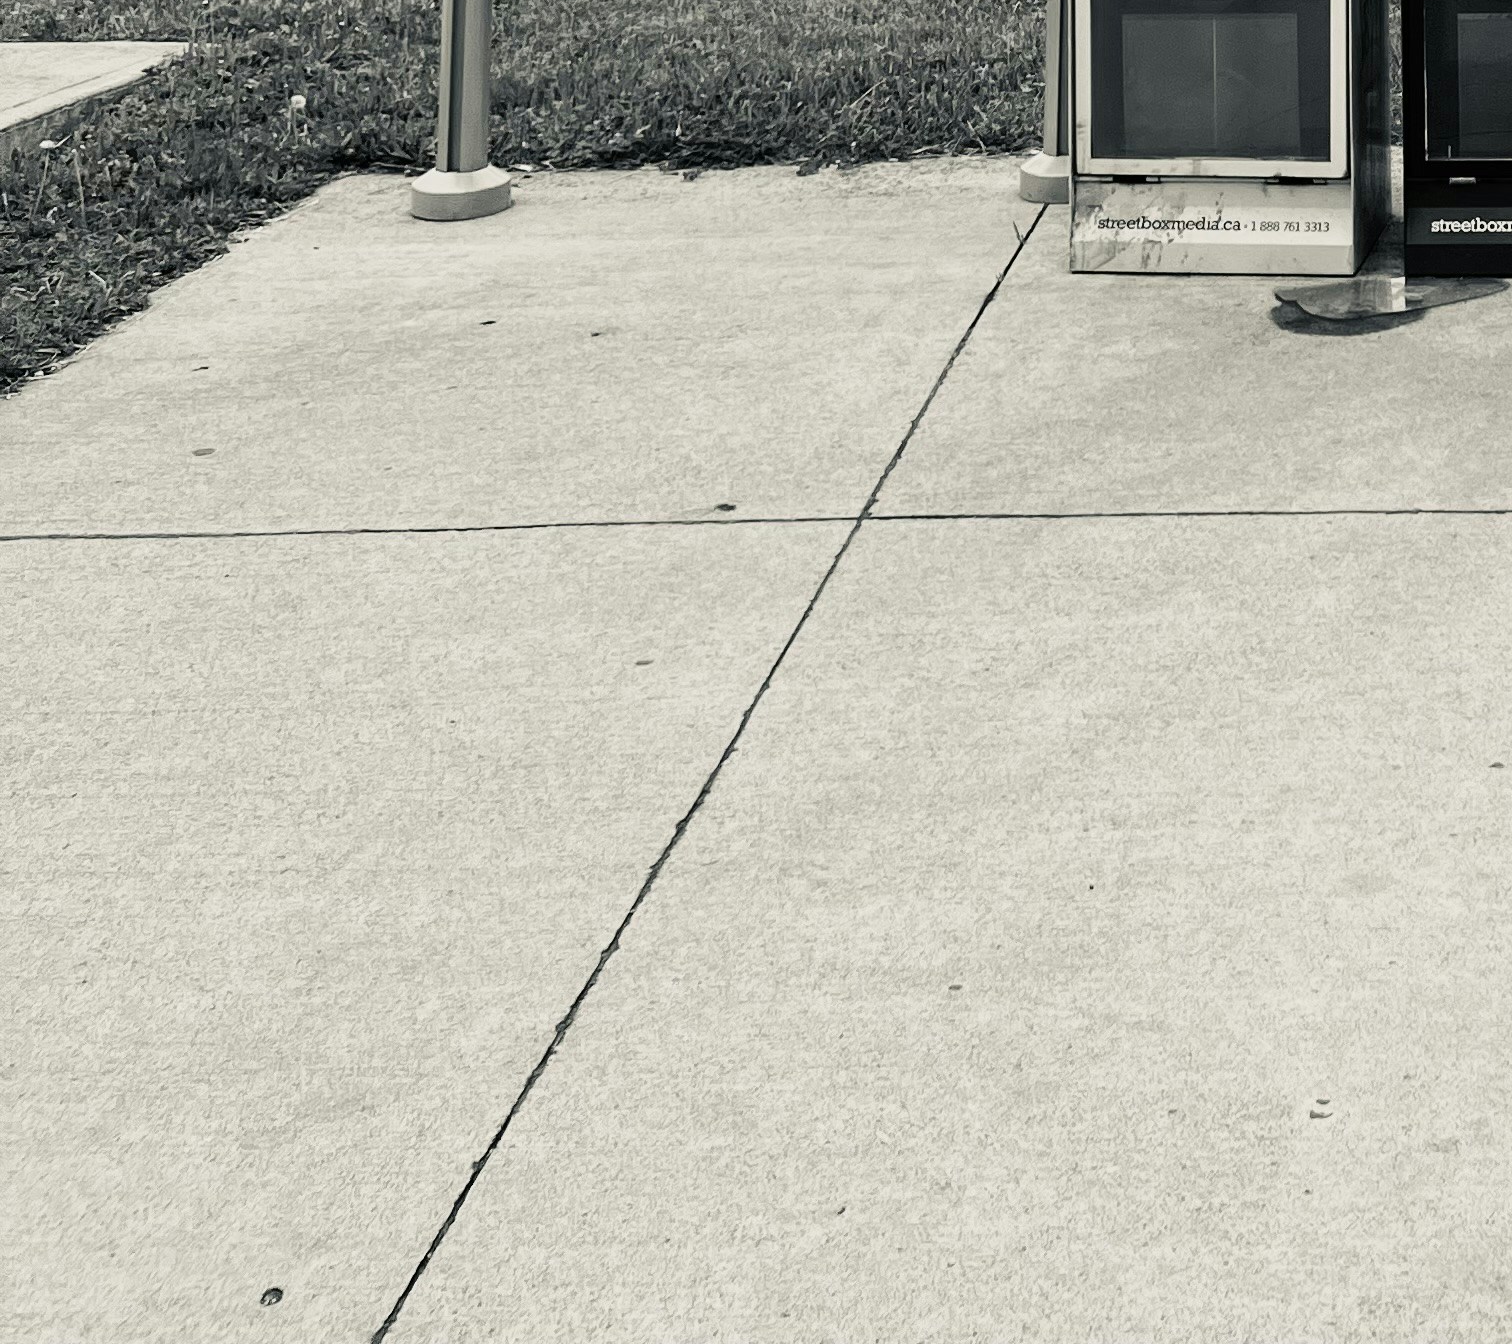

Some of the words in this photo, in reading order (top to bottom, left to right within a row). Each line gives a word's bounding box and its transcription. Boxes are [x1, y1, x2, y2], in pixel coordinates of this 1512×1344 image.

[1098, 216, 1241, 231] streetboxmedia.ca
[1251, 221, 1257, 232] 1
[1259, 221, 1280, 232] 888
[1283, 222, 1300, 232] 761
[1303, 222, 1330, 232] 3313
